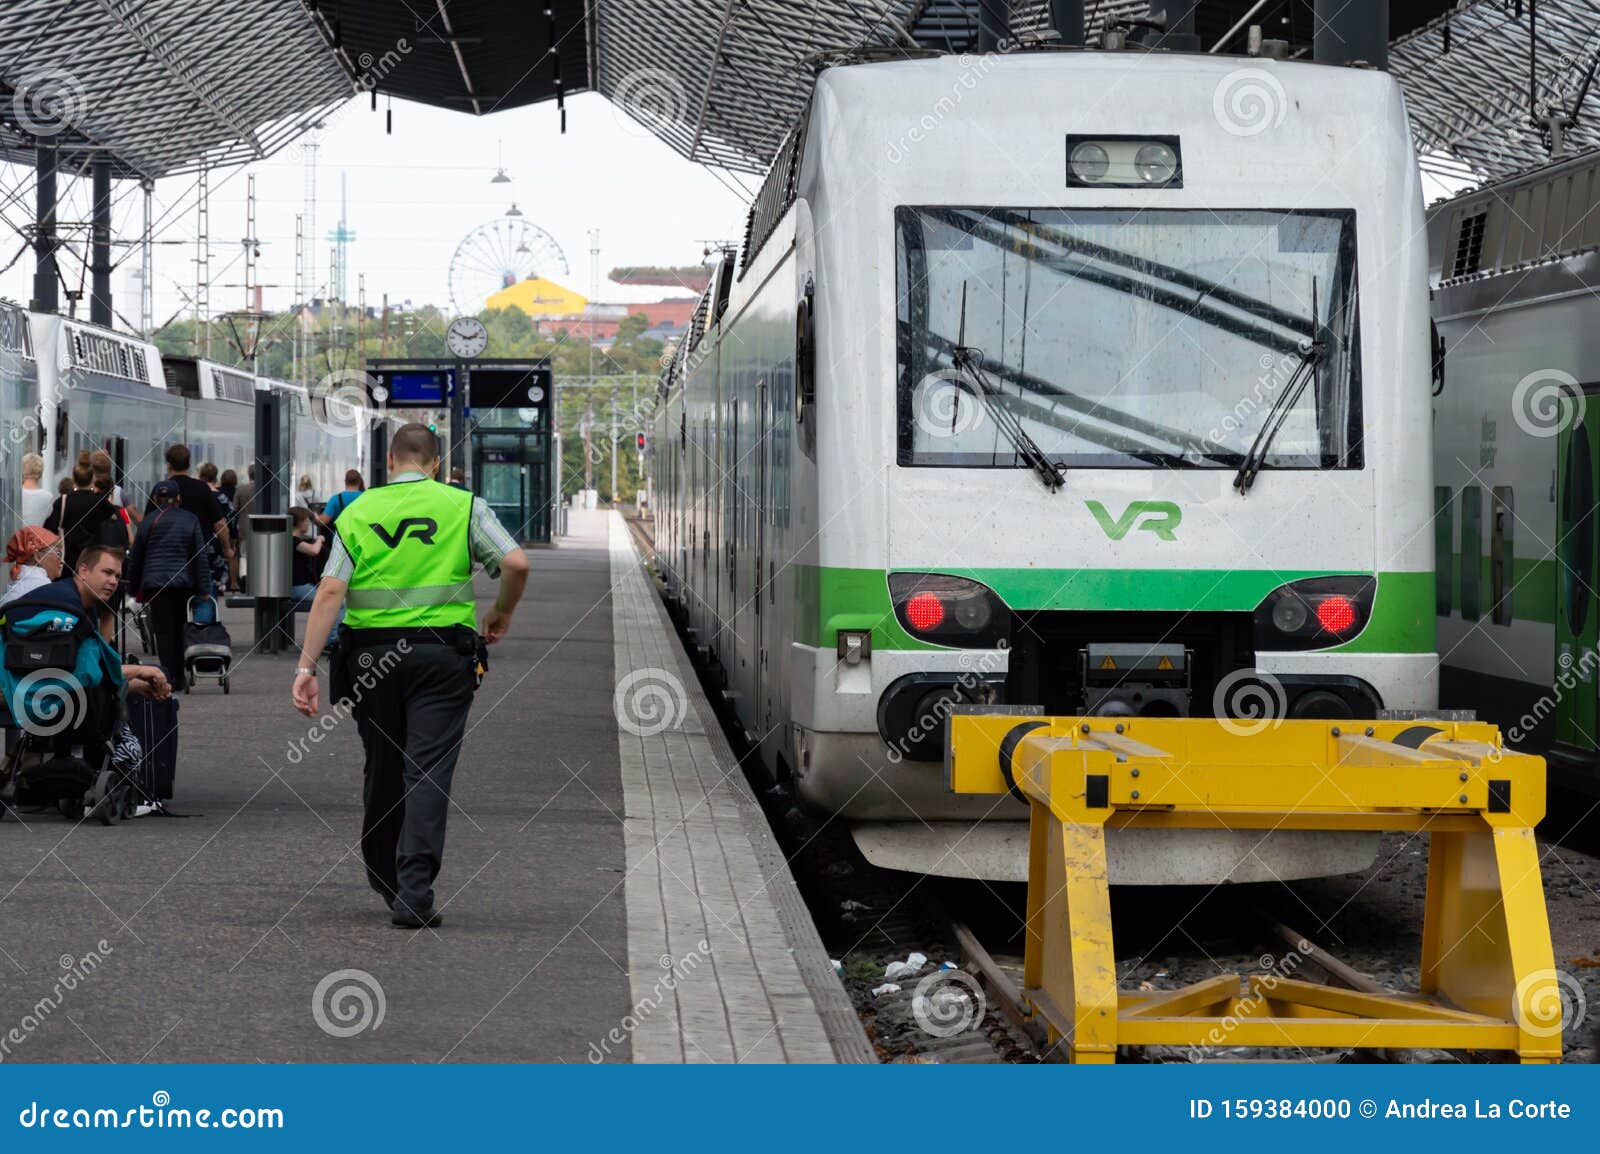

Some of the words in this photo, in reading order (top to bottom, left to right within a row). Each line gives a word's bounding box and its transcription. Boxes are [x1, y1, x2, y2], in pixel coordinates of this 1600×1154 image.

[532, 375, 540, 385] 7
[368, 517, 438, 549] VR
[1083, 500, 1182, 541] VR
